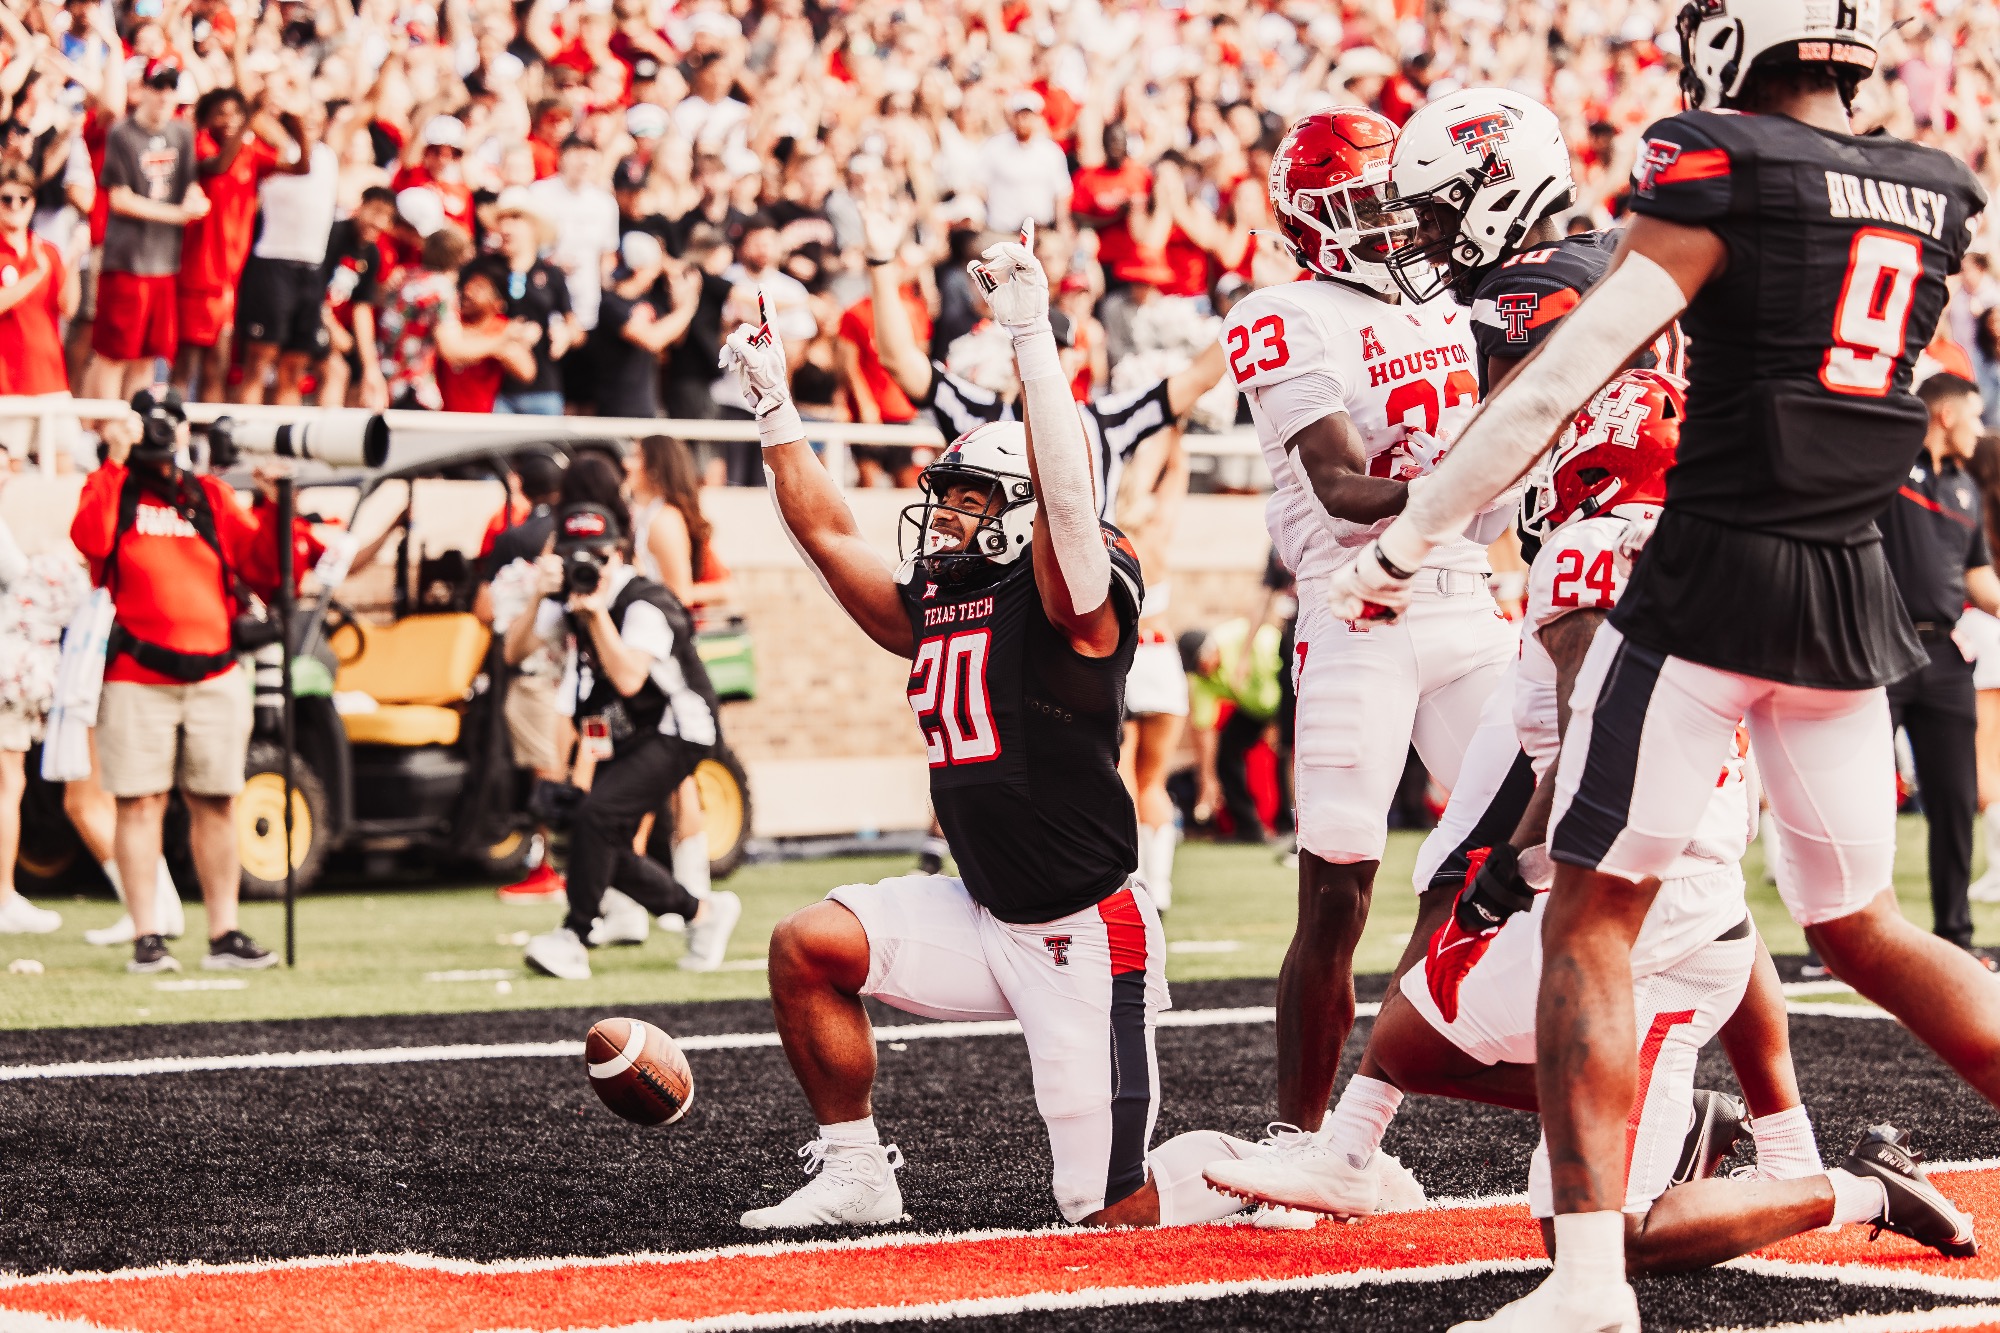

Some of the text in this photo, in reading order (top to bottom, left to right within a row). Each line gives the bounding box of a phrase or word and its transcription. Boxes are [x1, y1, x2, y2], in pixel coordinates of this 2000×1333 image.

[1825, 171, 1948, 240] BRADLEY
[1817, 226, 1924, 398] 9
[1227, 314, 1291, 384] 23
[1368, 343, 1470, 388] HOUSTON
[924, 596, 994, 628] TEXAS TECH
[1552, 549, 1616, 608] 24
[906, 627, 1002, 769] 20
